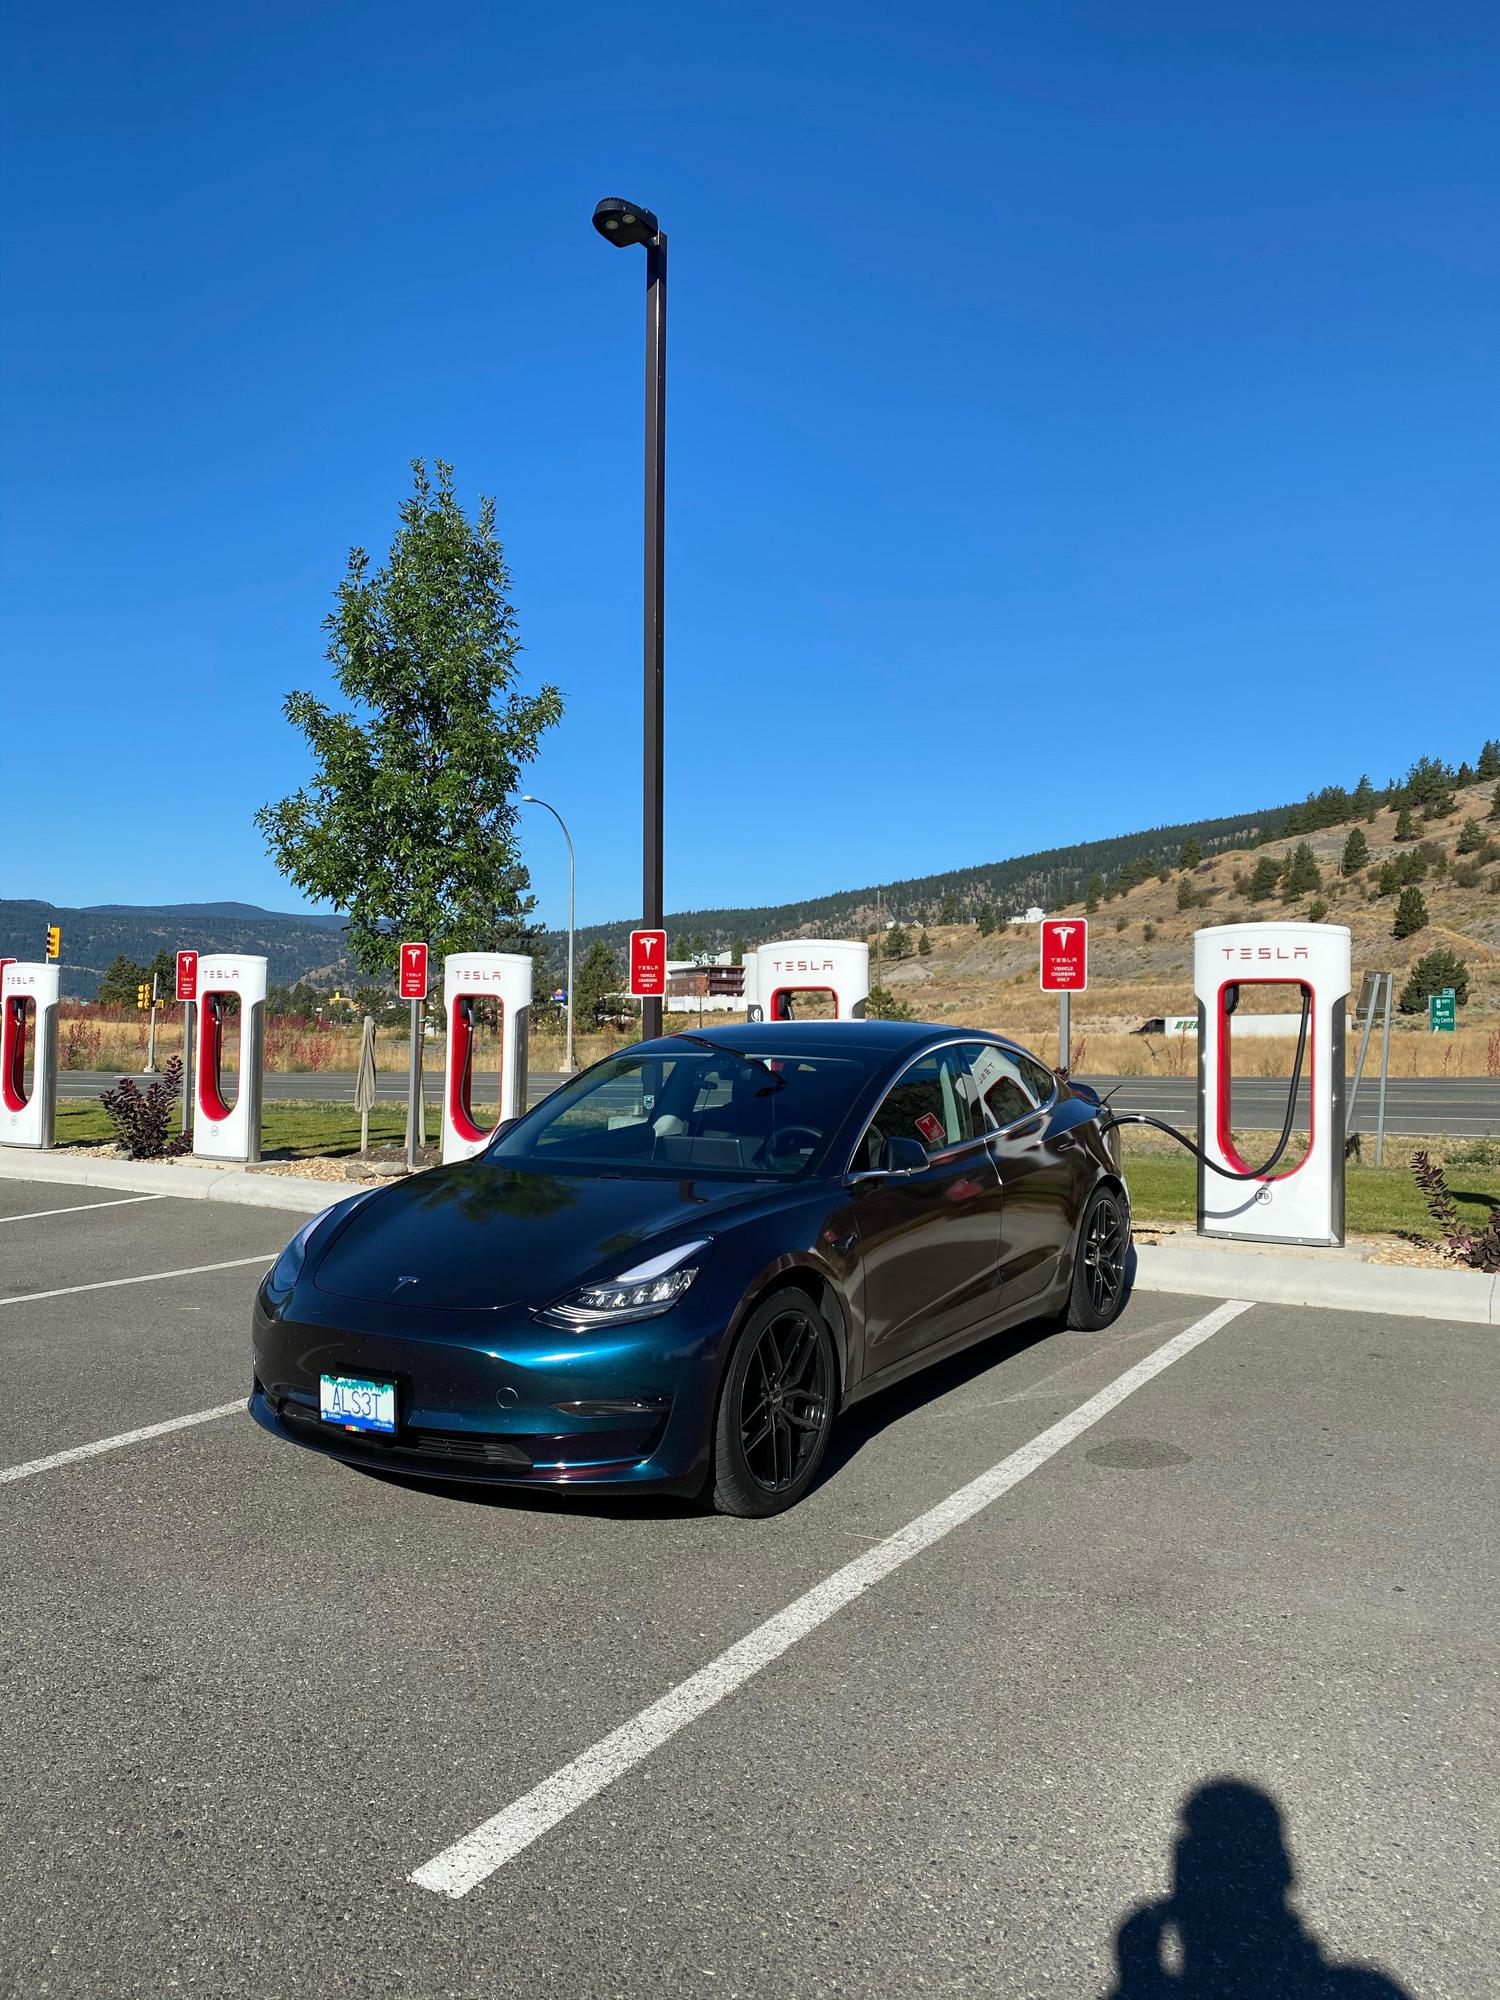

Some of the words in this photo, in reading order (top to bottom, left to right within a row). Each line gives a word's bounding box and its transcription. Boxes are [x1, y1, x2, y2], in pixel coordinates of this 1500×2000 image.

[1222, 947, 1309, 960] TESLA
[773, 960, 834, 972] TESLA
[203, 970, 240, 978] TESLA
[455, 970, 501, 980] TESLA
[7, 976, 35, 984] TESLA
[332, 1387, 381, 1418] ALS3T
